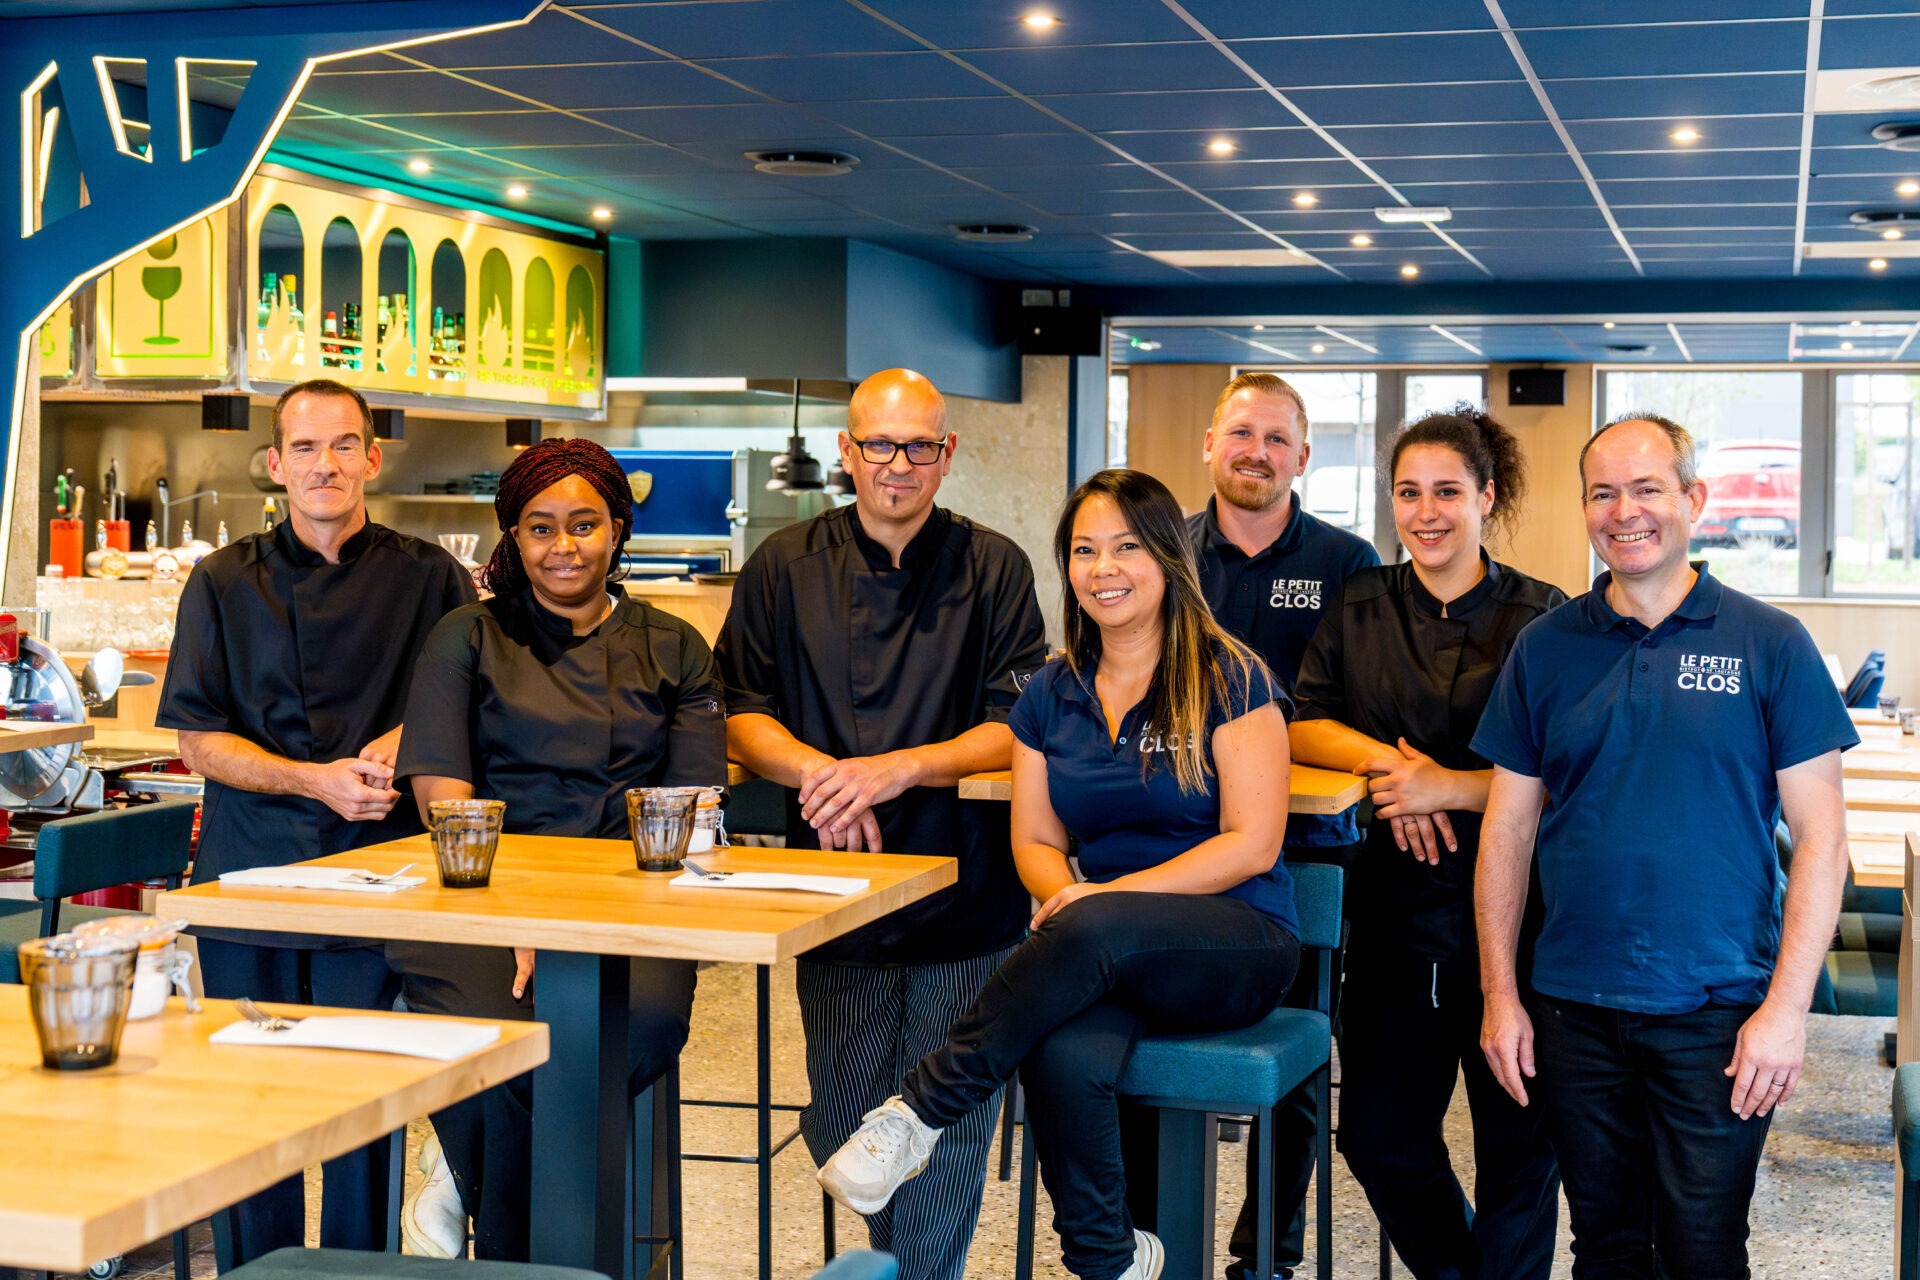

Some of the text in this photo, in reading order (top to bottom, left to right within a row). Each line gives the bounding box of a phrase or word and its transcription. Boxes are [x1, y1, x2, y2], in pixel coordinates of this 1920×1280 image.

[1272, 579, 1323, 591] LE PETIT
[1269, 593, 1321, 610] CLOS
[1680, 654, 1743, 670] LE PETIT
[1677, 672, 1741, 695] CLOS
